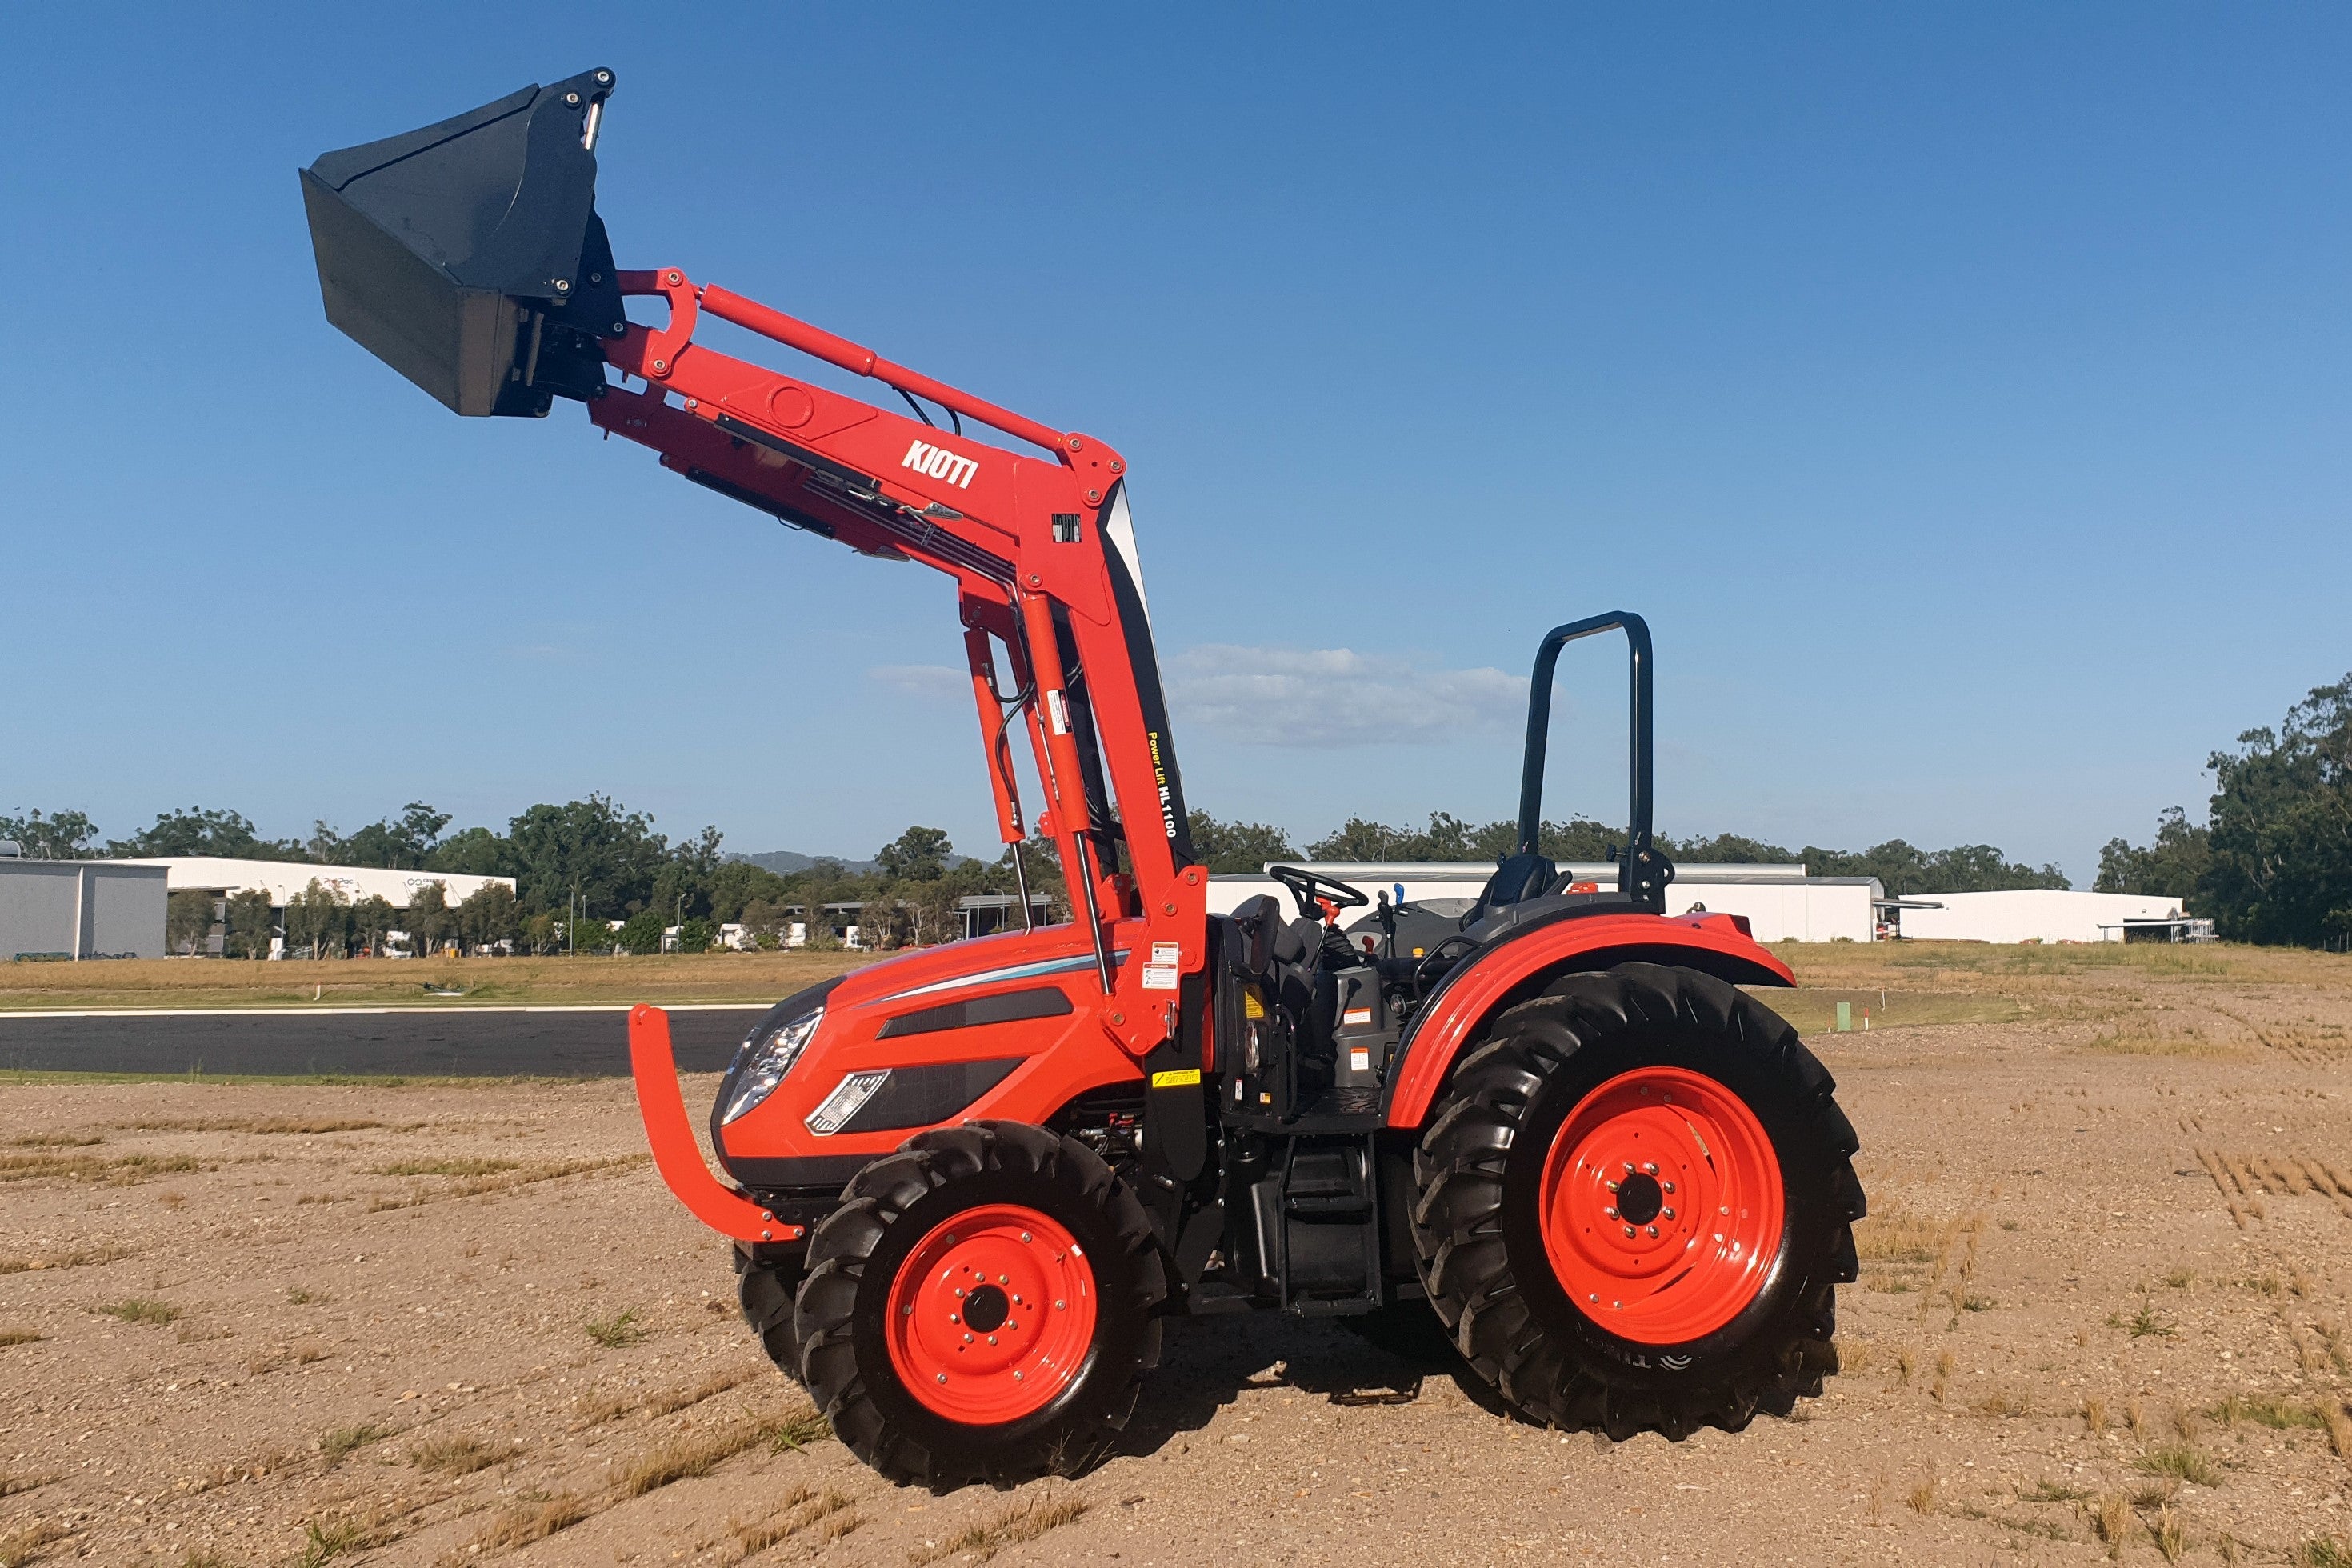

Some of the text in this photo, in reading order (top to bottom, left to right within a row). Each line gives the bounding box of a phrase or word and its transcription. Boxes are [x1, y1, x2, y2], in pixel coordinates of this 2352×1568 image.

[902, 439, 979, 490] KIOTI
[1148, 731, 1161, 765] Power
[1154, 767, 1166, 785] Lift
